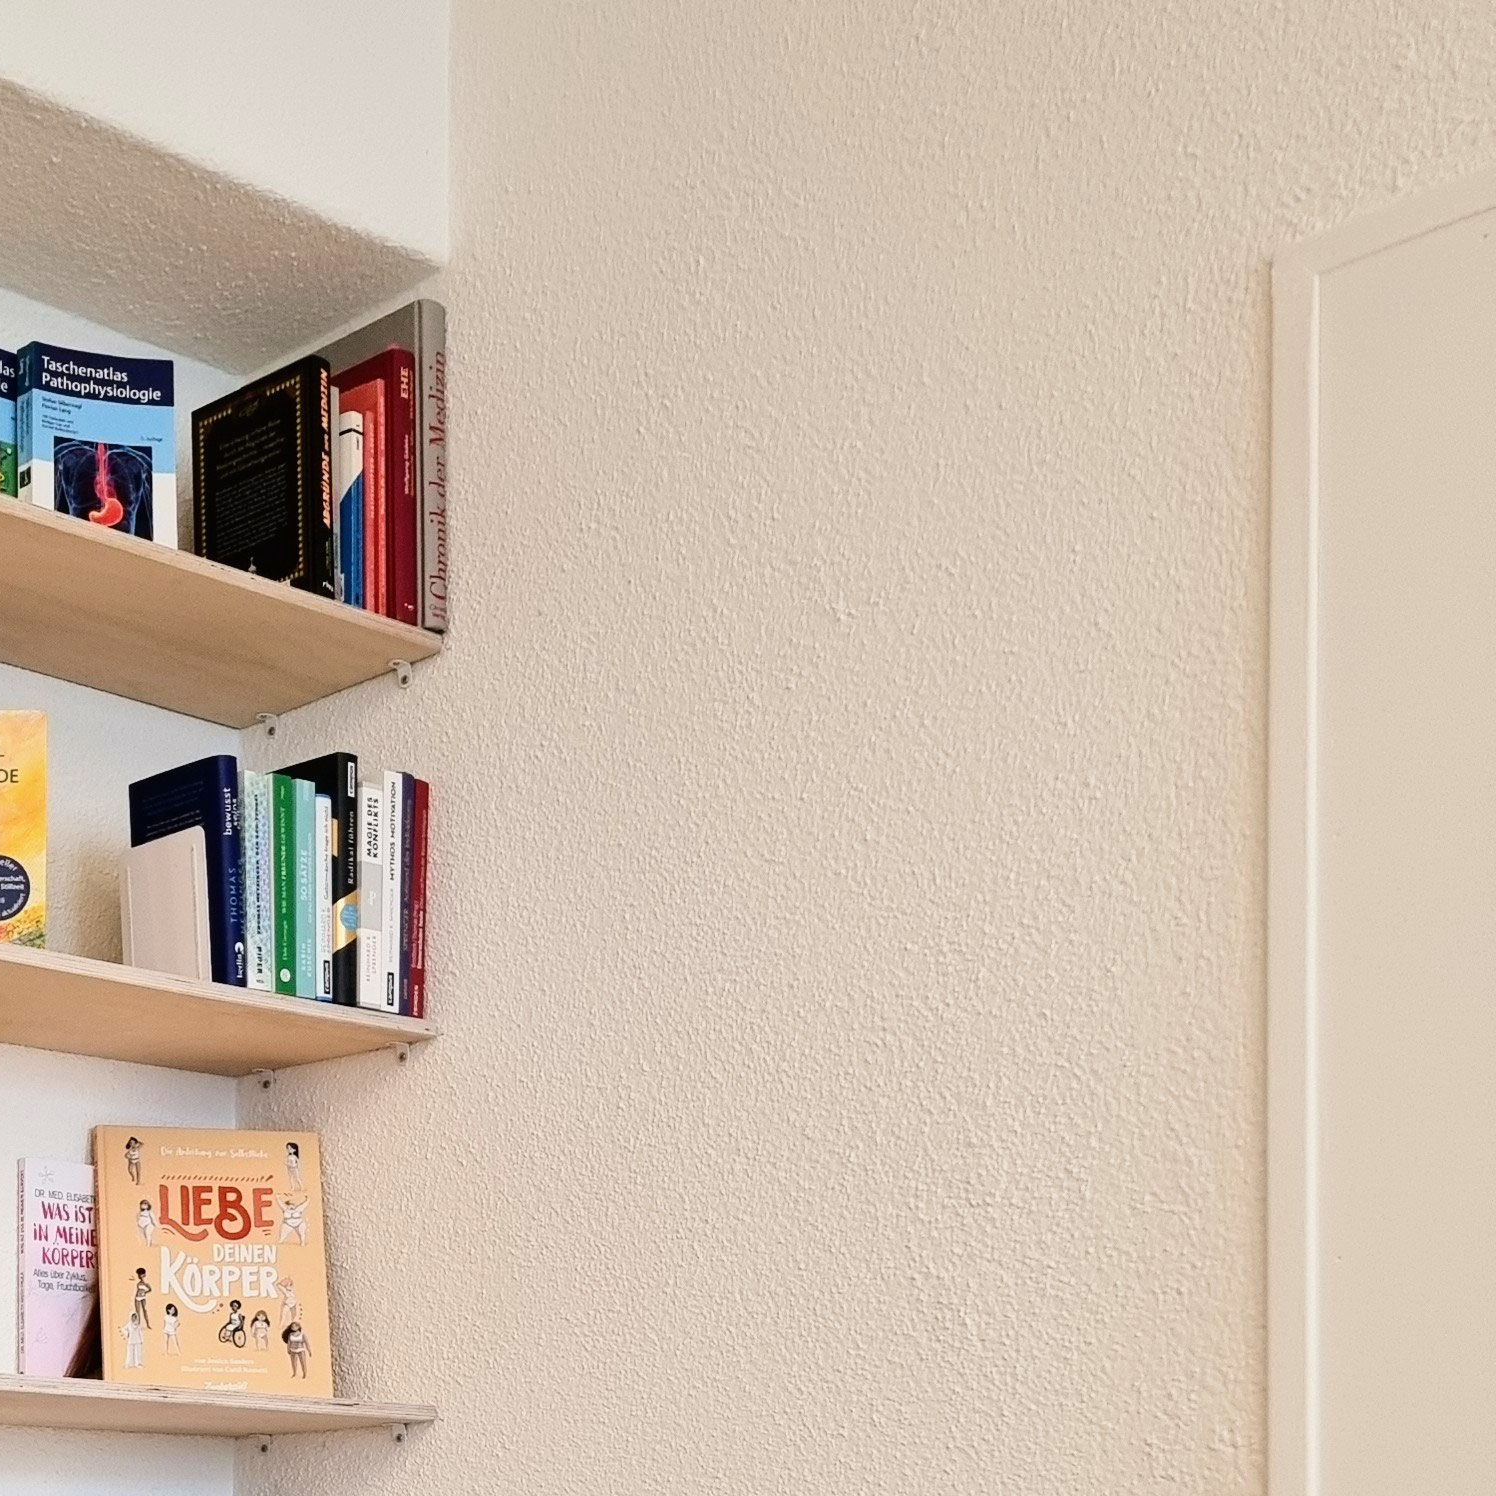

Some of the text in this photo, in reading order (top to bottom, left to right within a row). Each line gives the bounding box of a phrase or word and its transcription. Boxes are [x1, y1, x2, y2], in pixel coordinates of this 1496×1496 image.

[41, 356, 128, 382] Taschenatlas
[400, 367, 409, 399] EHE
[389, 781, 397, 838] MOTIVATION
[347, 811, 355, 843] führen
[159, 1184, 274, 1241] LIEBE
[213, 1243, 277, 1264] DEINEN
[160, 1245, 279, 1313] KÖRPER
